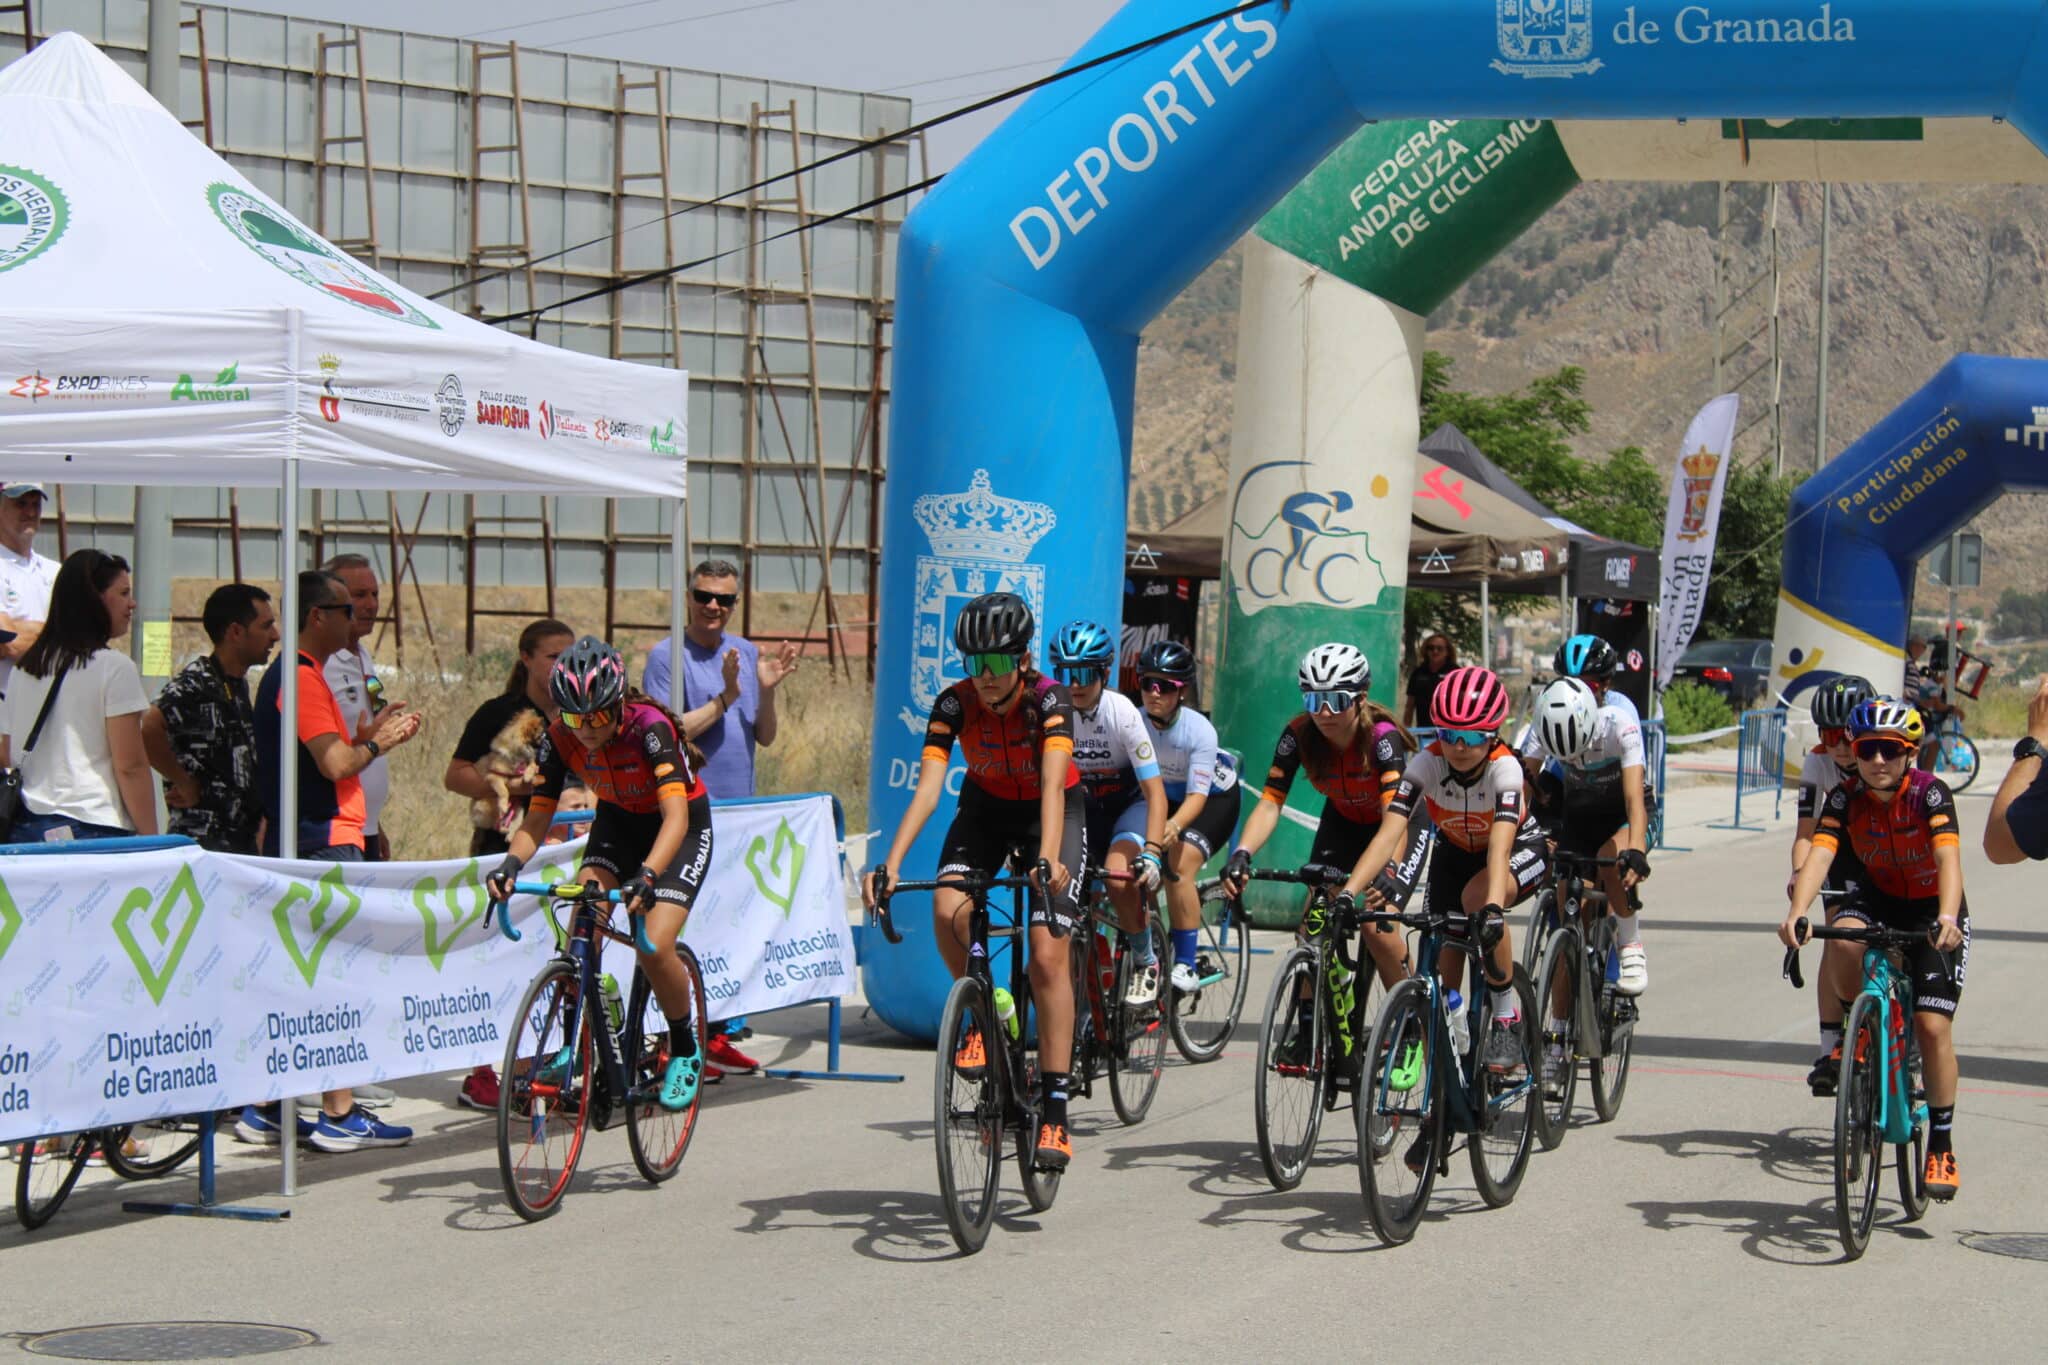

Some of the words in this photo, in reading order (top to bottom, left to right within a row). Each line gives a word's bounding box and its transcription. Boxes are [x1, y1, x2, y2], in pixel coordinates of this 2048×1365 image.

[1613, 5, 1660, 44] de
[1675, 2, 1856, 44] Granada
[1009, 0, 1277, 270] DEPORTES
[1350, 120, 1460, 211] FEDERA
[1389, 207, 1431, 248] DE
[1428, 120, 1542, 214] CICLISMO
[1338, 138, 1469, 262] ANDALUZA
[170, 373, 250, 401] Ameral
[480, 390, 502, 401] POLLOS
[477, 400, 530, 430] SABROSUR
[1837, 417, 1960, 514] Participación
[1868, 448, 1968, 524] Ciudadana
[687, 828, 711, 884] MOBALPA
[1402, 829, 1429, 882] MOBALPA
[764, 928, 840, 965] Diputación
[764, 969, 787, 990] de
[786, 956, 844, 982] Granada
[267, 1002, 361, 1043] Diputación
[403, 986, 491, 1025] Diputación
[107, 1021, 212, 1066] Diputación
[266, 1047, 288, 1075] de
[293, 1037, 369, 1070] Granada
[404, 1028, 425, 1054] de
[427, 1017, 499, 1051] Granada
[104, 1069, 130, 1099] de
[136, 1057, 217, 1095] Granada
